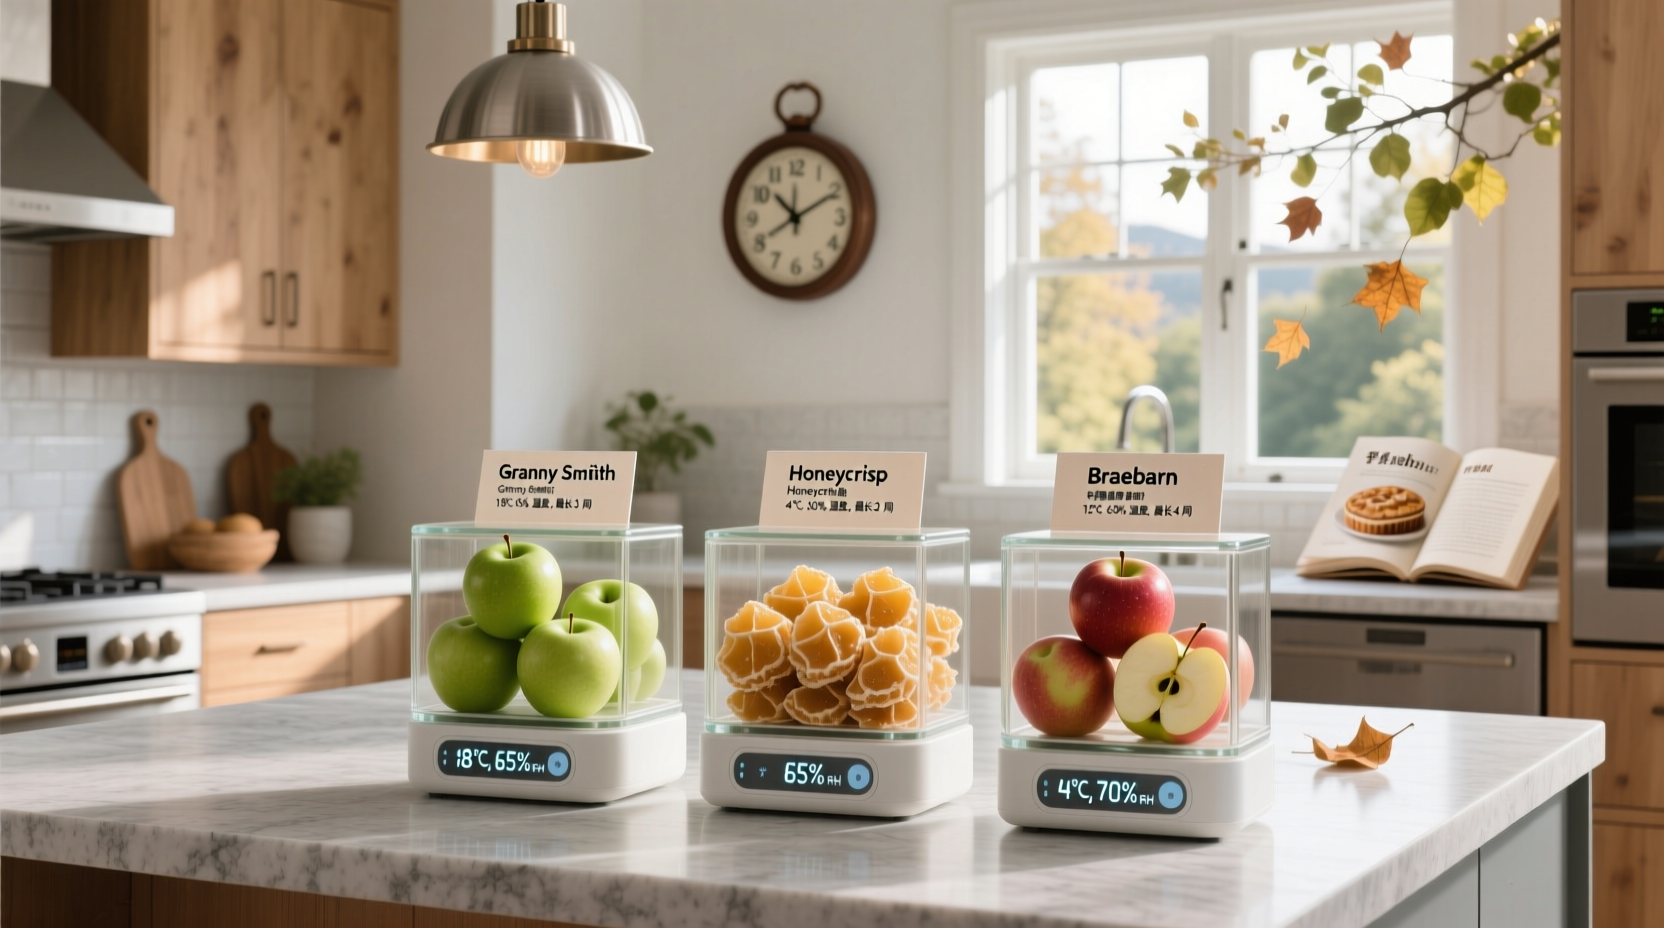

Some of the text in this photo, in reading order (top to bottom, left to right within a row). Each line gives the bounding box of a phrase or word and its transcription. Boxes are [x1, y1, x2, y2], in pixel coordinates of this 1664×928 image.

[769, 166, 781, 183] 11
[789, 159, 805, 177] 12
[816, 164, 821, 182] 1
[753, 186, 770, 204] 10
[829, 182, 840, 199] 2
[747, 211, 758, 228] 9
[834, 208, 846, 227] 3
[754, 234, 766, 252] 8
[827, 234, 838, 251] 4
[771, 252, 781, 270] 7
[790, 258, 802, 275] 6
[813, 252, 824, 270] 5
[499, 464, 558, 484] Granny
[789, 464, 888, 487] Honeycrisp
[1088, 466, 1178, 486] Braebarn
[495, 750, 530, 772] 65%
[784, 761, 825, 785] 65%
[1057, 778, 1093, 804] 4°C,
[1096, 780, 1137, 804] 70%
